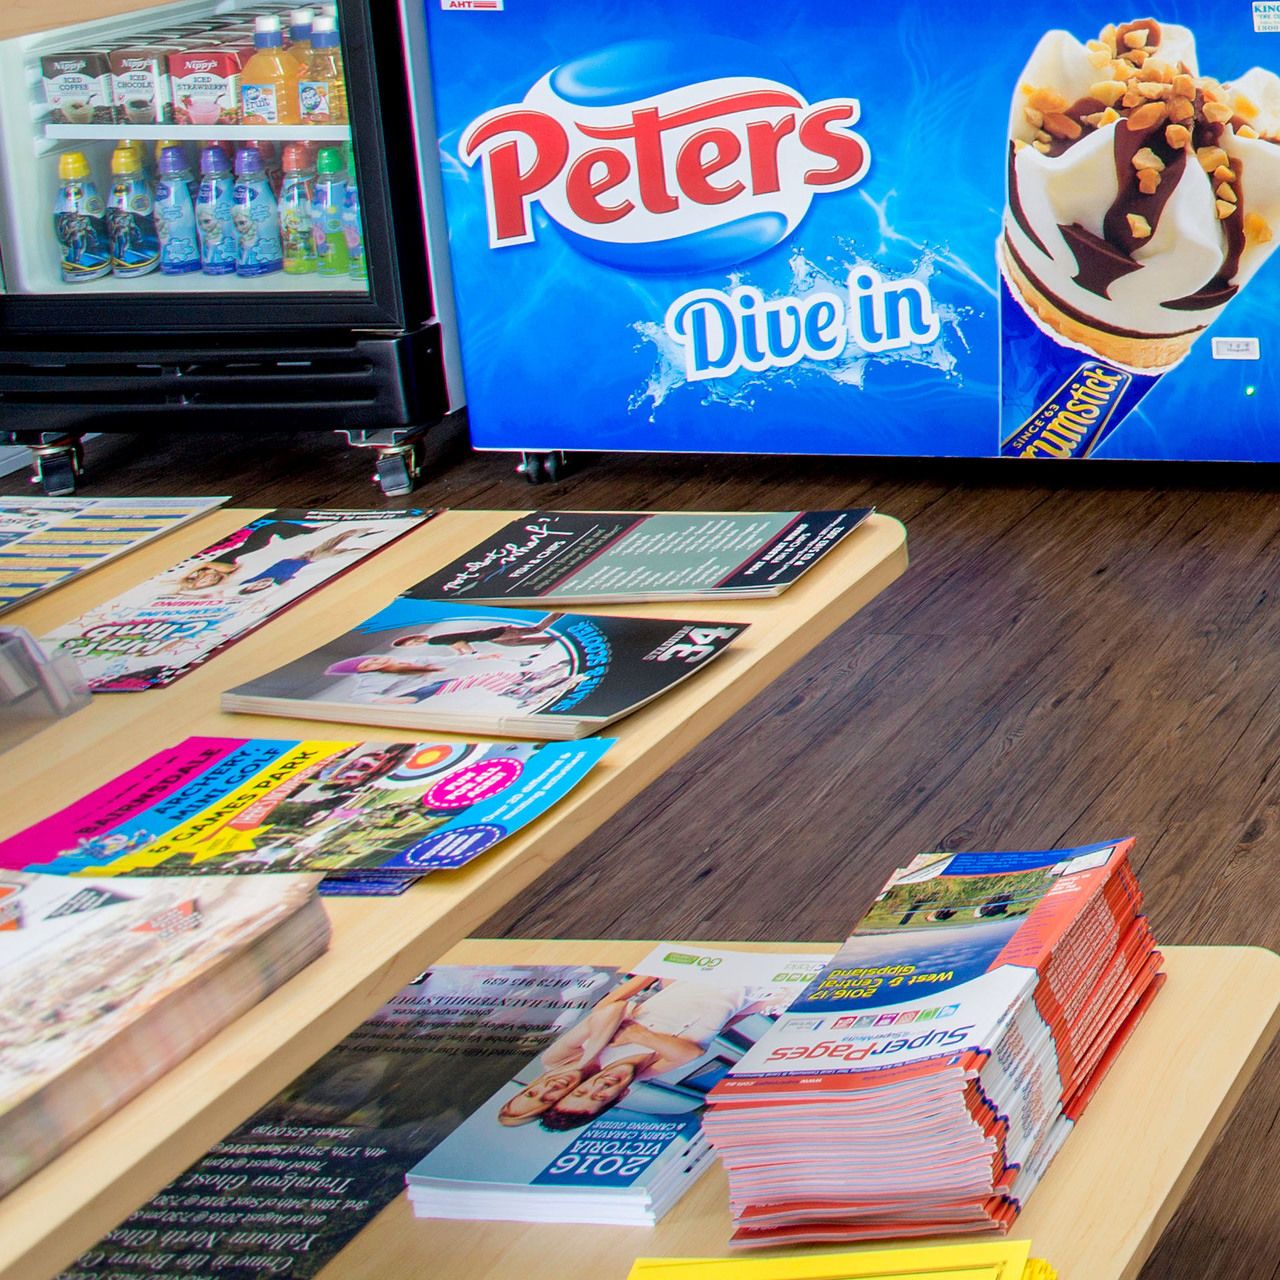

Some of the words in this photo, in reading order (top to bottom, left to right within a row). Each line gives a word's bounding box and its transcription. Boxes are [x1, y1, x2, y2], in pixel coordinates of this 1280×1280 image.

[449, 1, 472, 9] AHT
[464, 89, 866, 241] Peters
[683, 292, 843, 375] Dive
[856, 272, 936, 352] in
[1020, 368, 1121, 458] rumstick
[1013, 419, 1043, 449] SINCE
[172, 793, 257, 842] GAMES
[255, 750, 318, 789] PARK
[828, 964, 916, 979] Gippsland
[908, 971, 954, 986] West
[809, 987, 877, 1001] 2016/17
[820, 977, 883, 992] Central
[763, 1025, 975, 1064] SuperPages
[582, 1128, 638, 1140] CARAVAN
[570, 1140, 662, 1155] VICTORIA
[550, 1155, 640, 1176] 2016
[163, 1230, 227, 1249] North
